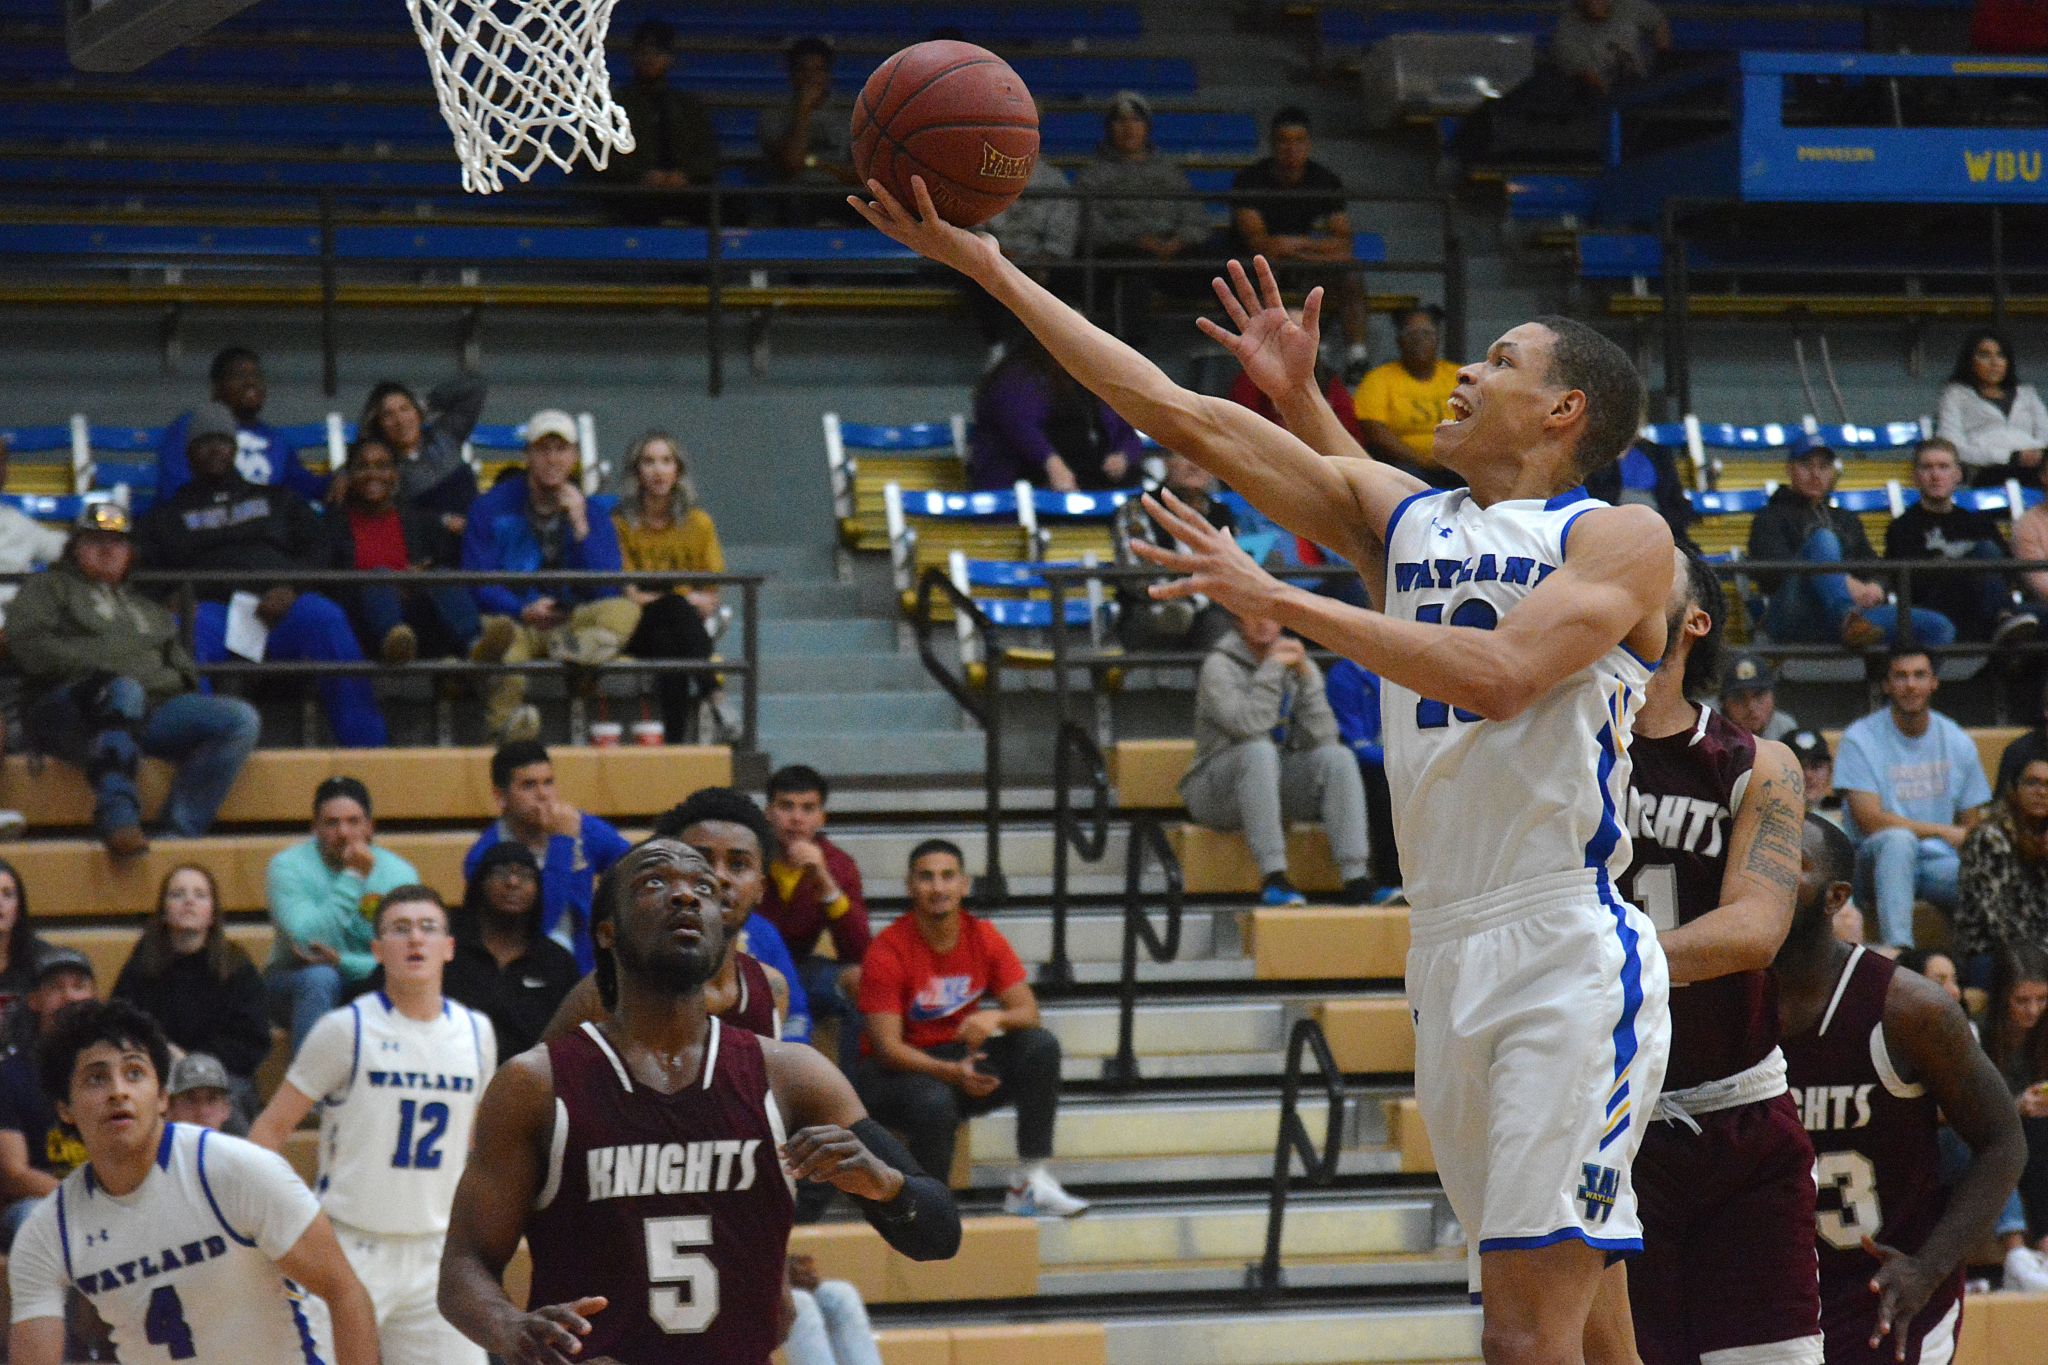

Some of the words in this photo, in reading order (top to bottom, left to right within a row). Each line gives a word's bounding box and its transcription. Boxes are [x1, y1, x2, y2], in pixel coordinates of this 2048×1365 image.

[1964, 149, 2042, 182] WBU
[367, 1070, 474, 1092] WAYLAND
[391, 1099, 449, 1168] 12
[587, 1139, 762, 1202] KNIGHTS
[76, 1235, 227, 1296] WAYLAND
[643, 1214, 720, 1334] 5
[145, 1284, 197, 1361] 4
